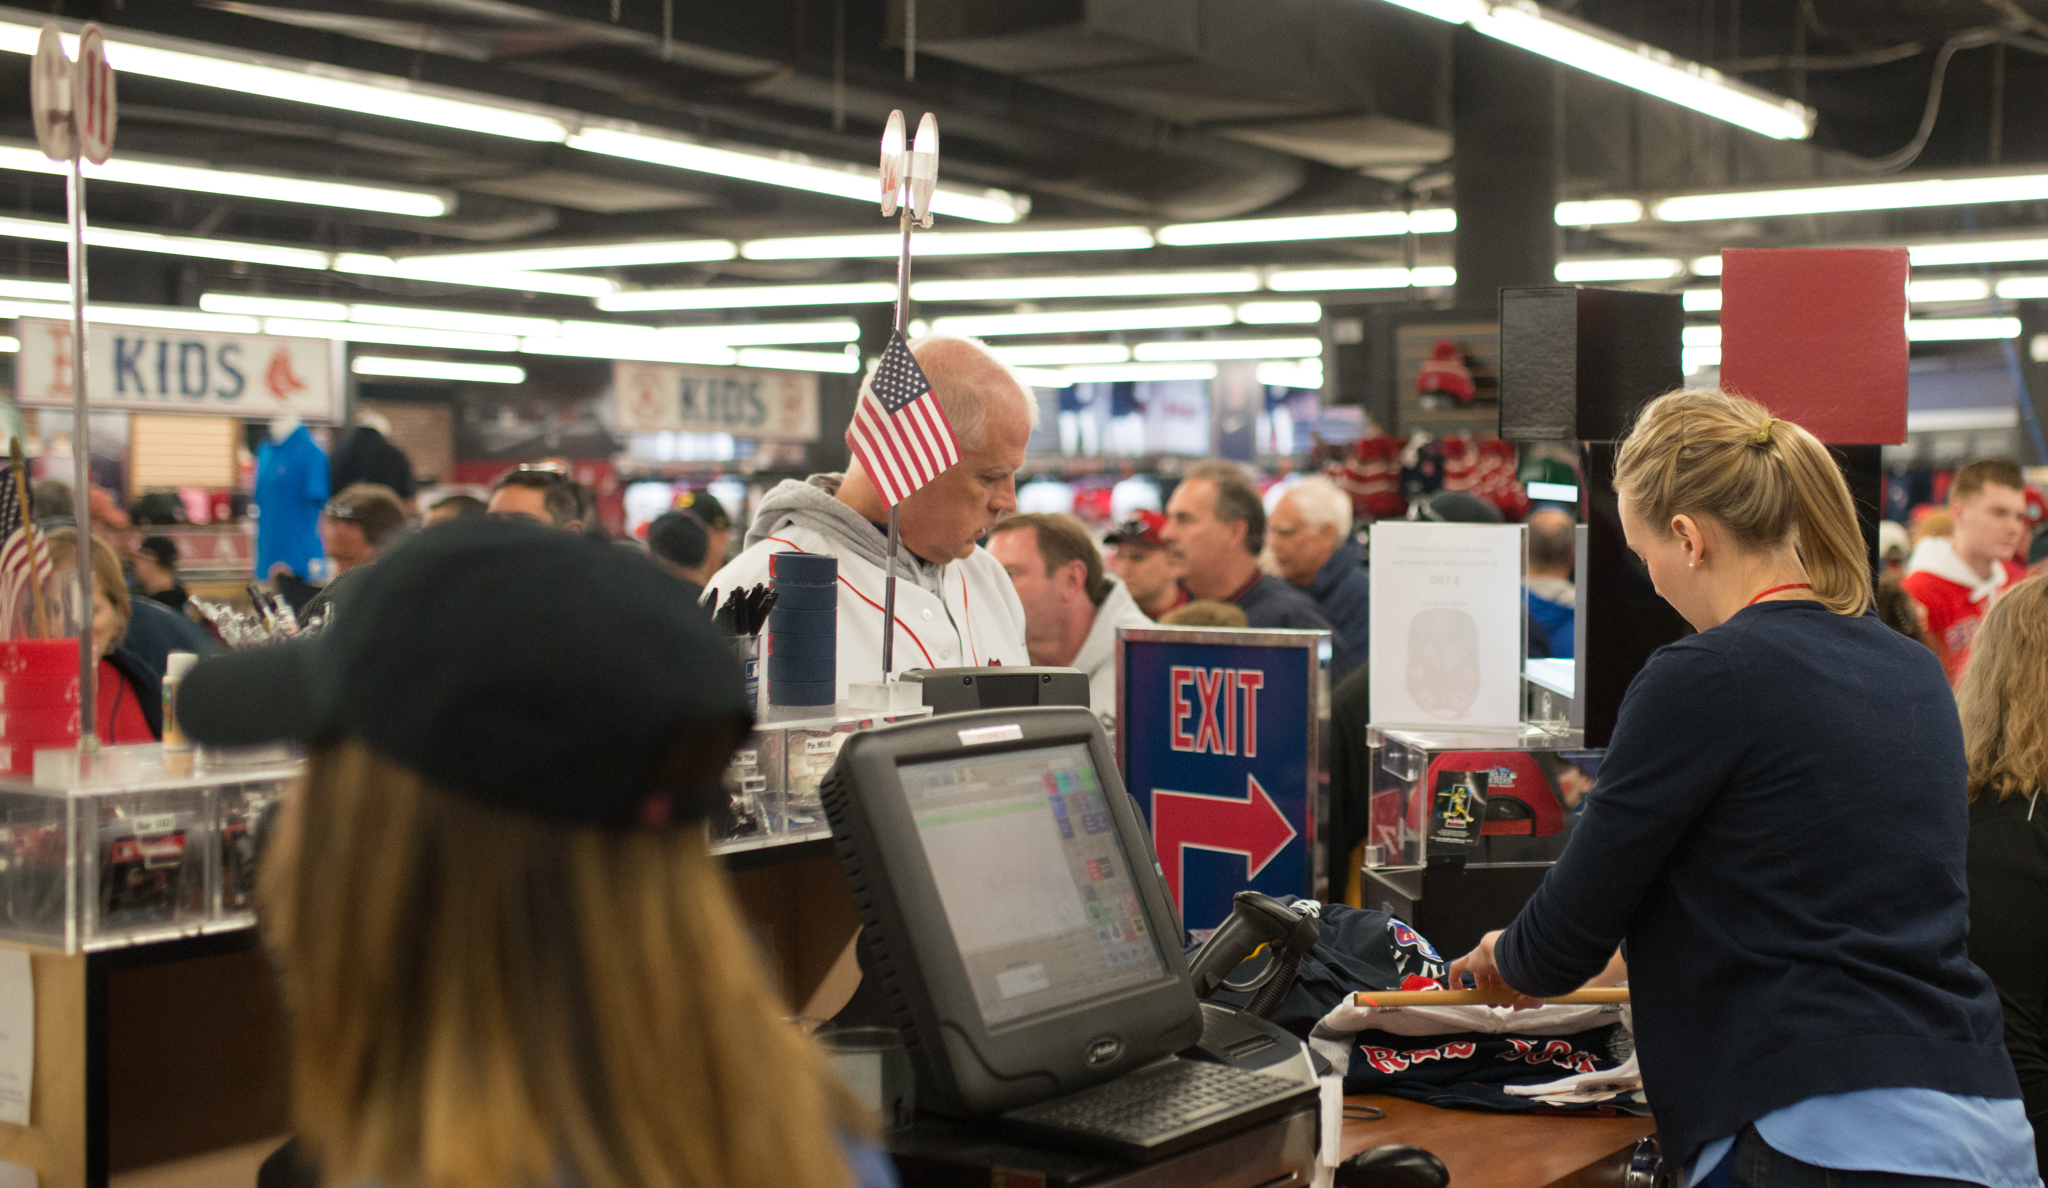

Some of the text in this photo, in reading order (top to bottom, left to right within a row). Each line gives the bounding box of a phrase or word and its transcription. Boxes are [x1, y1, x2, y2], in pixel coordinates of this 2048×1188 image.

[113, 336, 246, 399] KIDS
[679, 376, 767, 428] KIDS
[1169, 665, 1264, 758] EXIT
